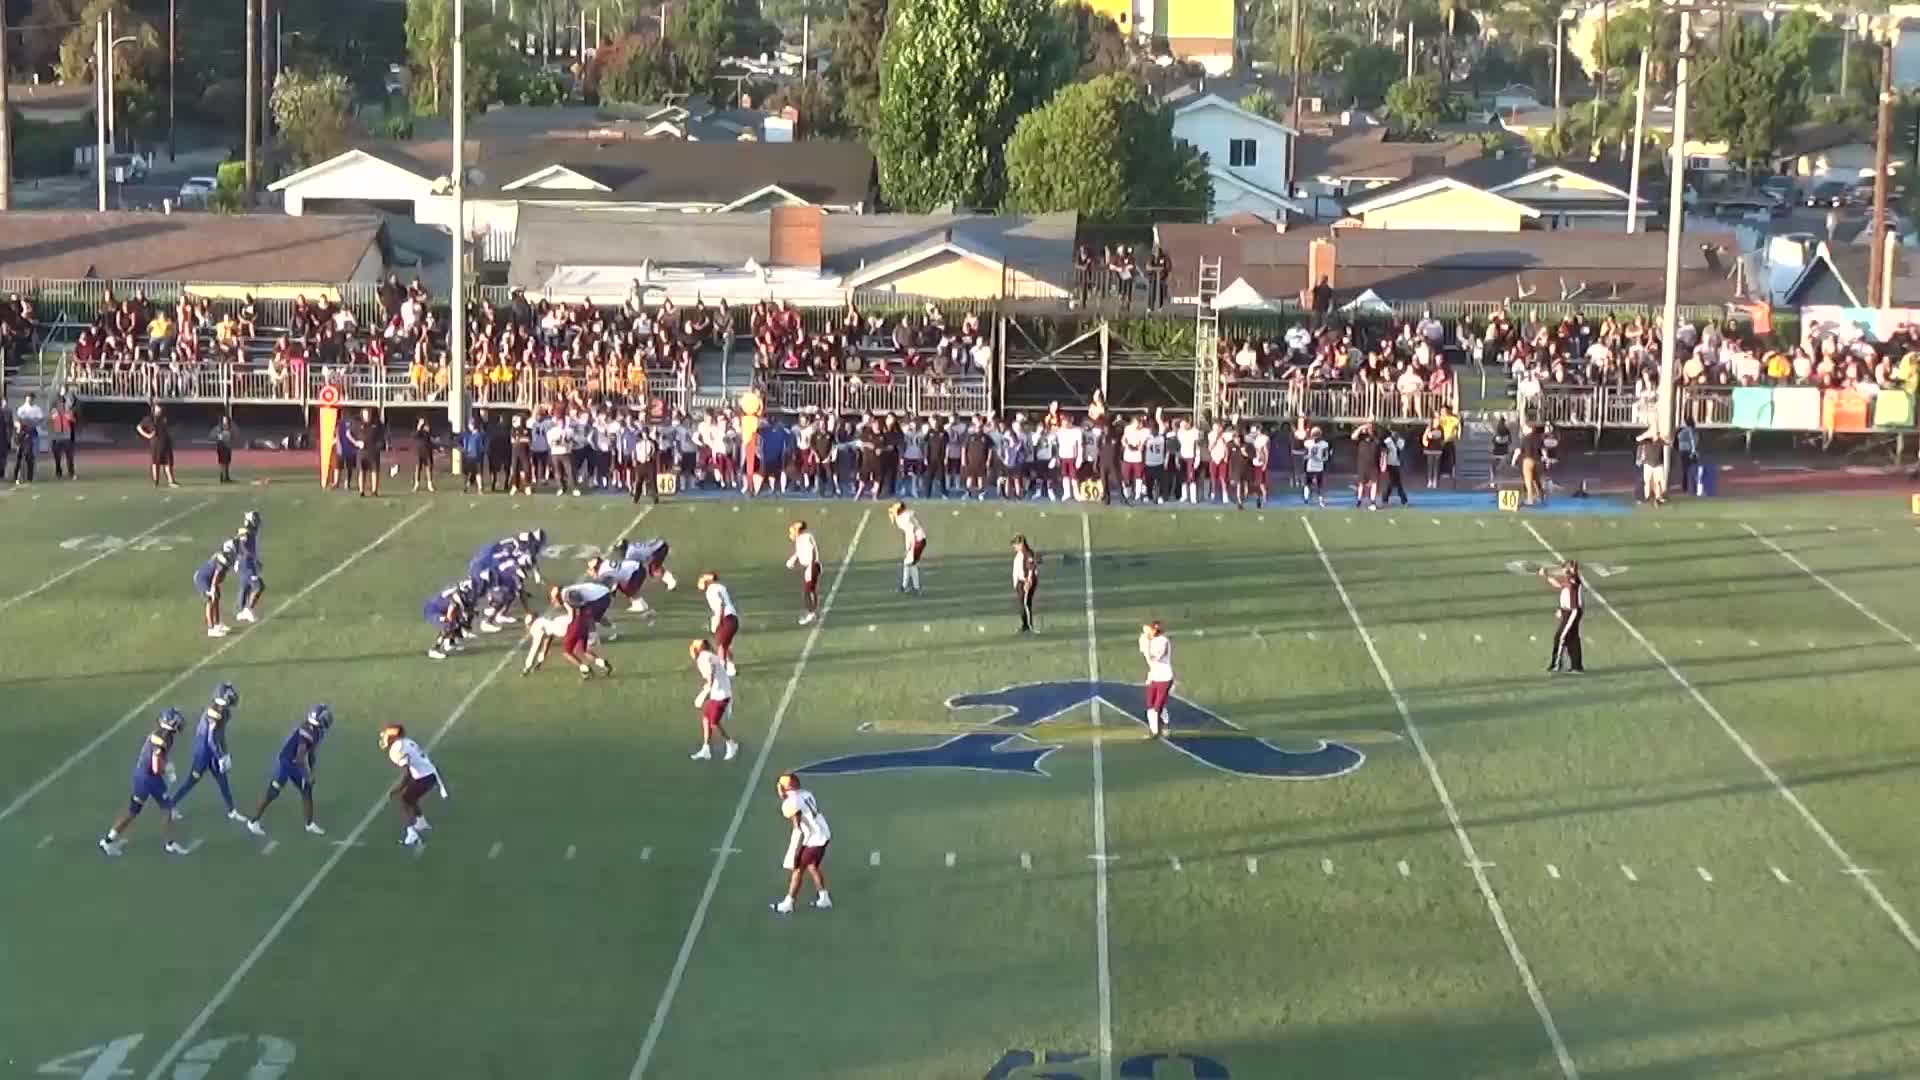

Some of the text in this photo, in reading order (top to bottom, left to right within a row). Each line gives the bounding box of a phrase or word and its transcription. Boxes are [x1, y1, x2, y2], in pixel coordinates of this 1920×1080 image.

[659, 477, 674, 490] 40
[1084, 486, 1099, 498] 50
[1502, 493, 1517, 507] 40
